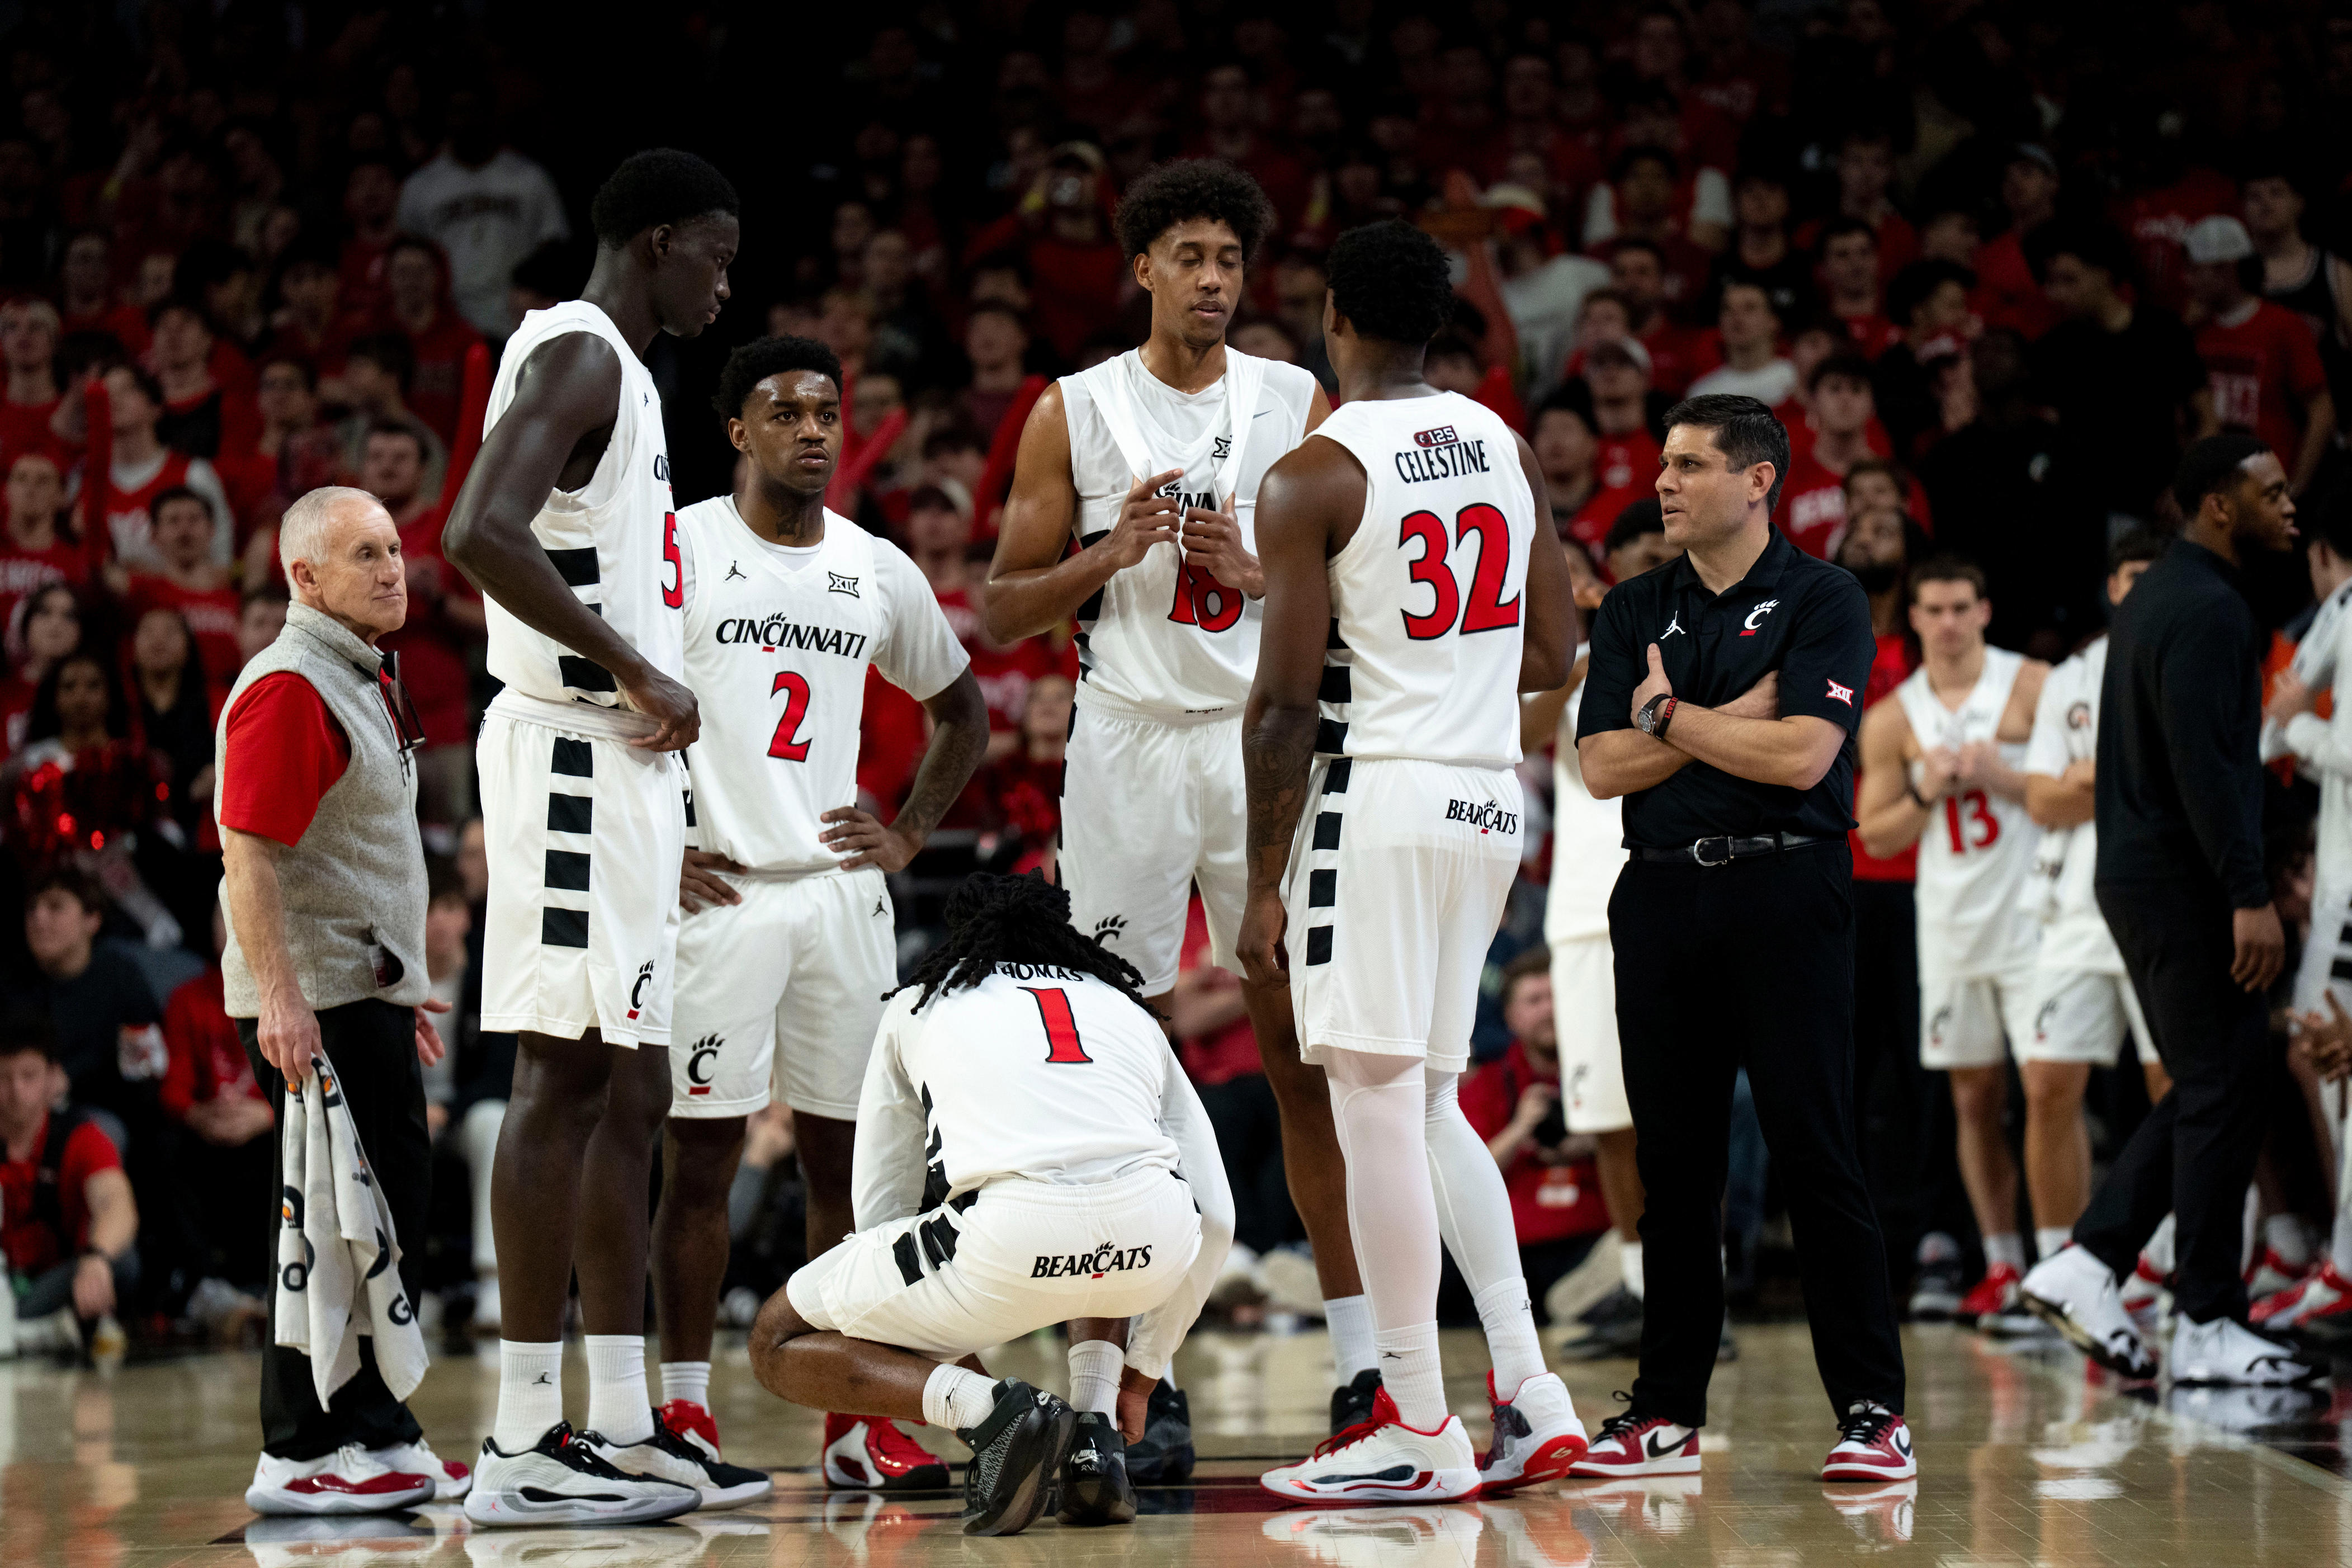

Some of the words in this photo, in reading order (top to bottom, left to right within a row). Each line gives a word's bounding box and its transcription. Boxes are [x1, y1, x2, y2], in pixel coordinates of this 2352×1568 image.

[1427, 427, 1456, 444] 125
[1395, 440, 1490, 484] CELESTINE
[1398, 502, 1521, 641] 32
[715, 614, 867, 659] CINCINNATI
[767, 671, 813, 762] 2
[1445, 799, 1518, 835] BEARCATS
[1945, 788, 1999, 854] 13
[1017, 986, 1093, 1063] 1
[1030, 1242, 1153, 1278] BEARCATS
